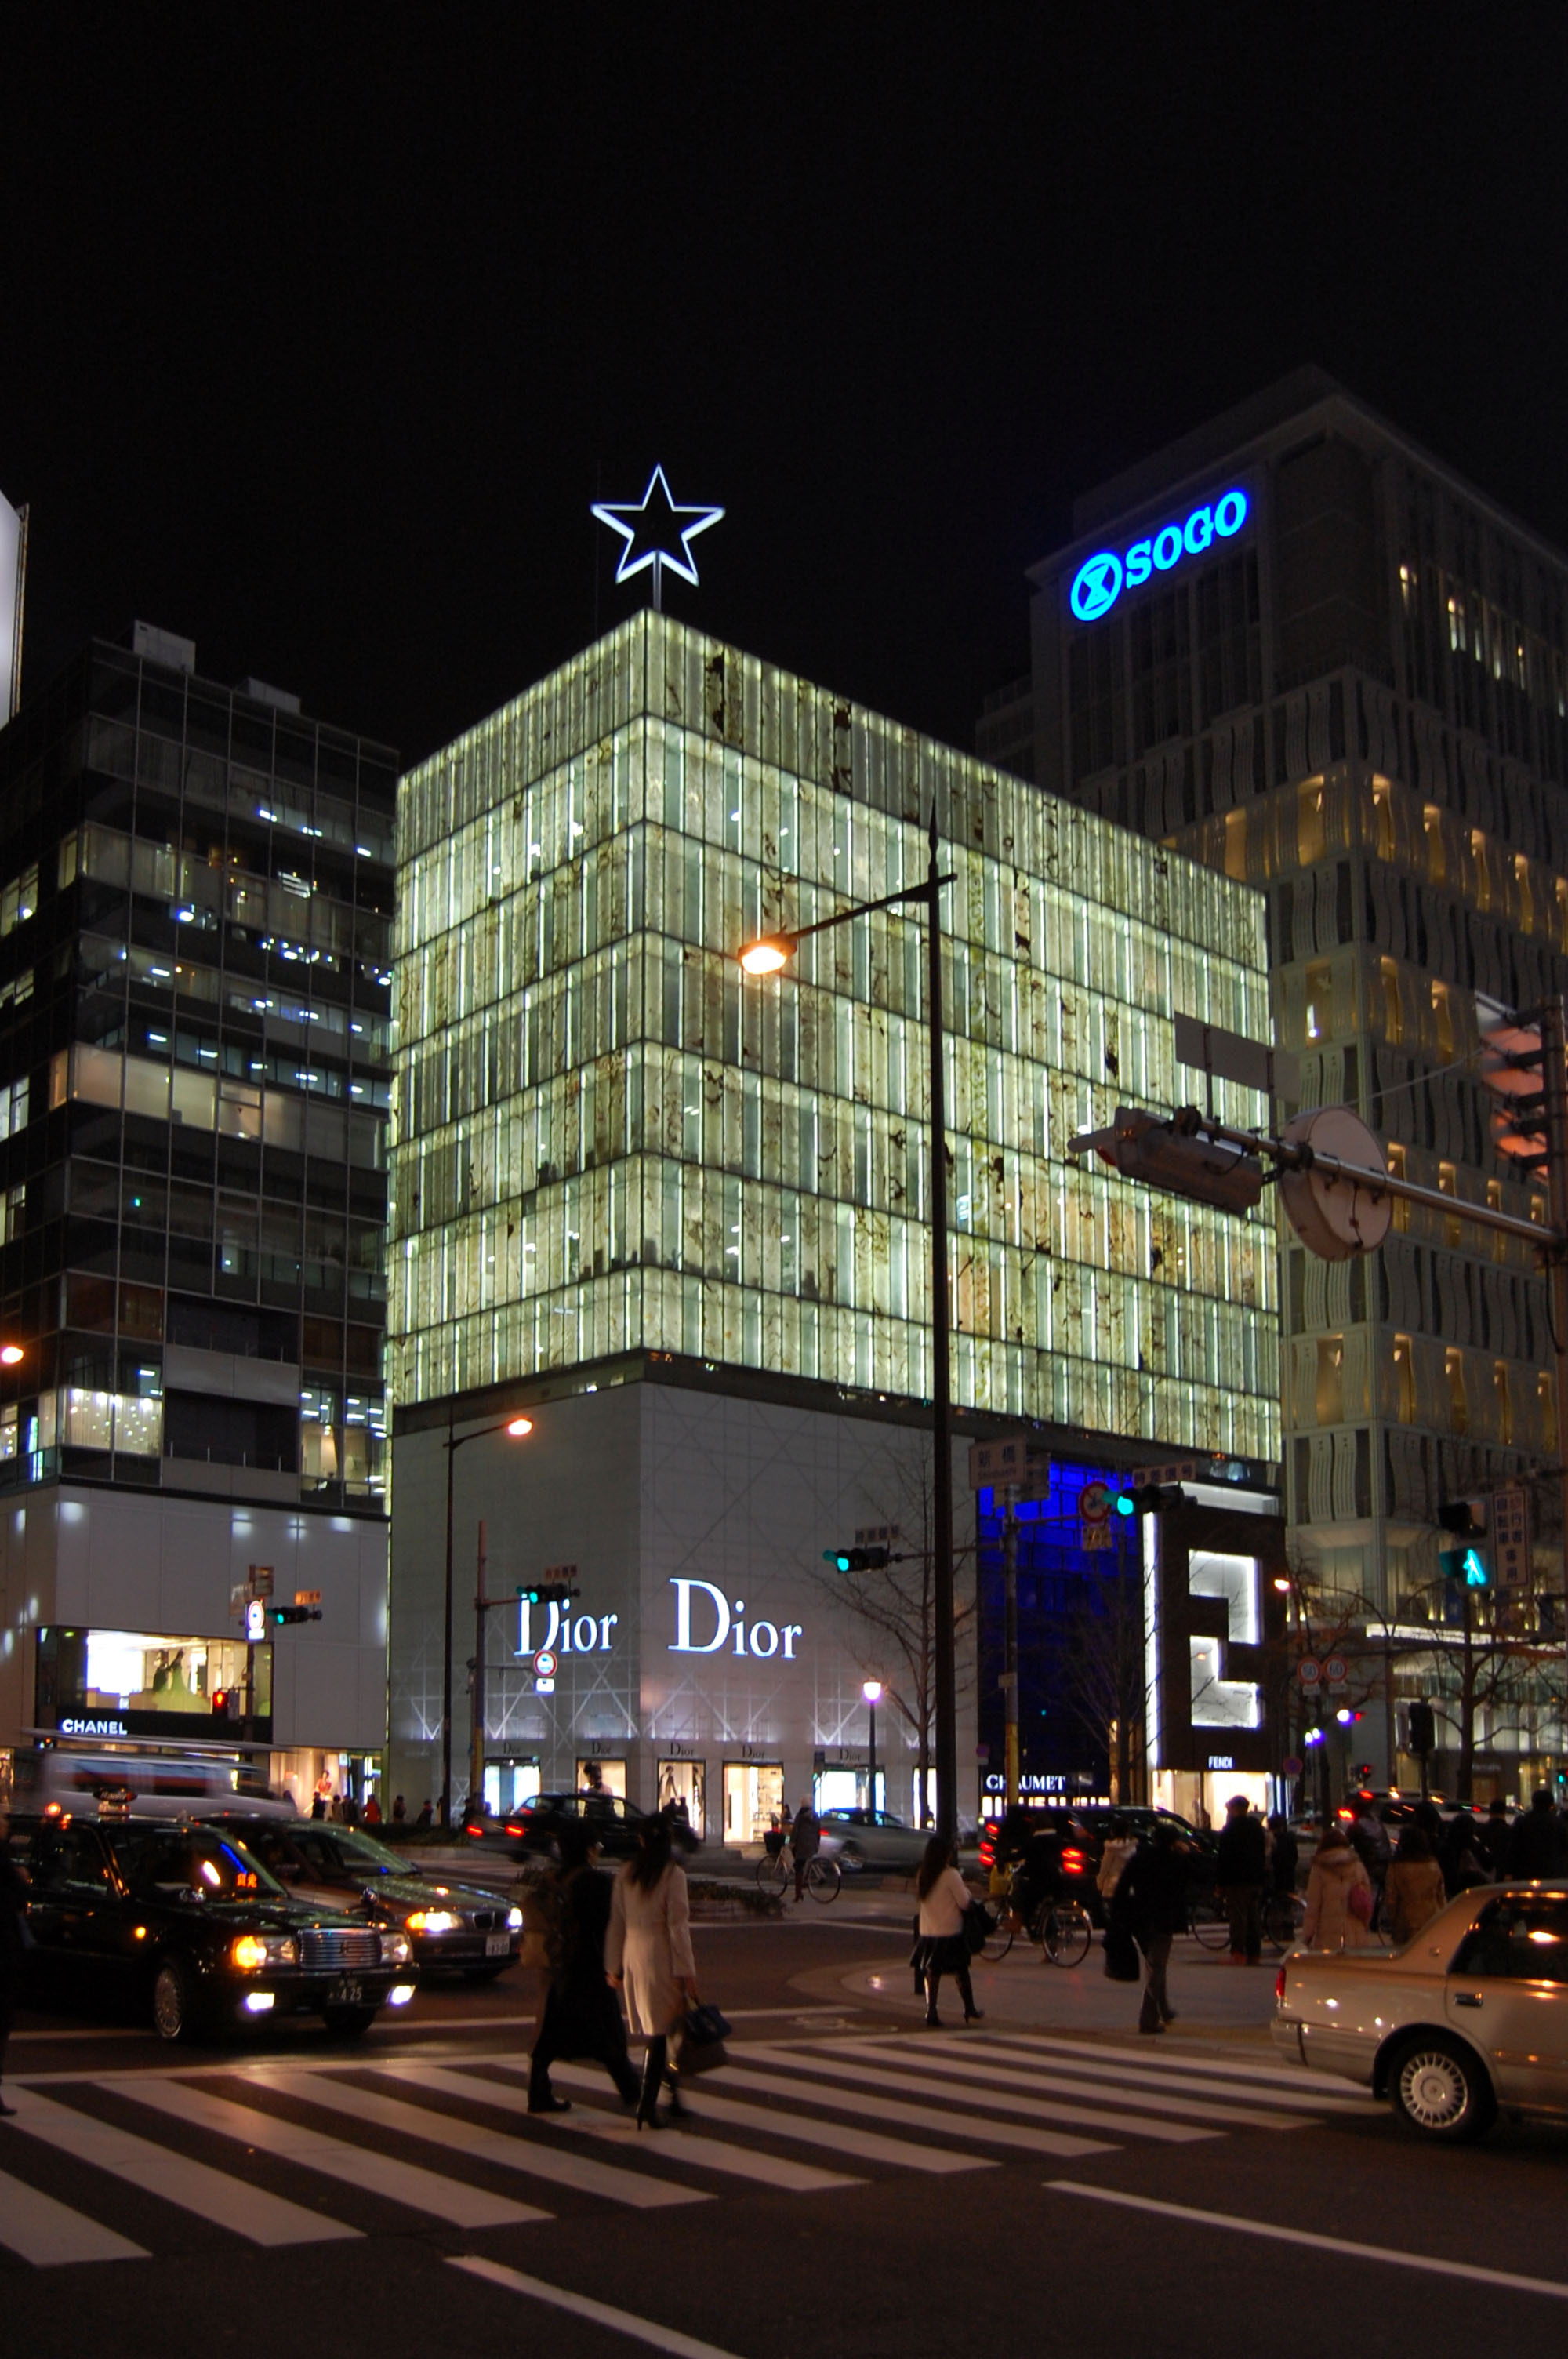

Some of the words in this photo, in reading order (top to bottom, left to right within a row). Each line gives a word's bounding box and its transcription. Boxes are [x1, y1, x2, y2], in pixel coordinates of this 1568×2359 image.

[1125, 491, 1247, 590] SOGO
[514, 1592, 618, 1656] Dior
[667, 1577, 803, 1659] Dior
[62, 1718, 128, 1736] CHANEL
[670, 1741, 695, 1757] Dior
[742, 1744, 766, 1759] Dior
[1208, 1755, 1233, 1769] FENDI
[985, 1773, 1066, 1790] CHUMET
